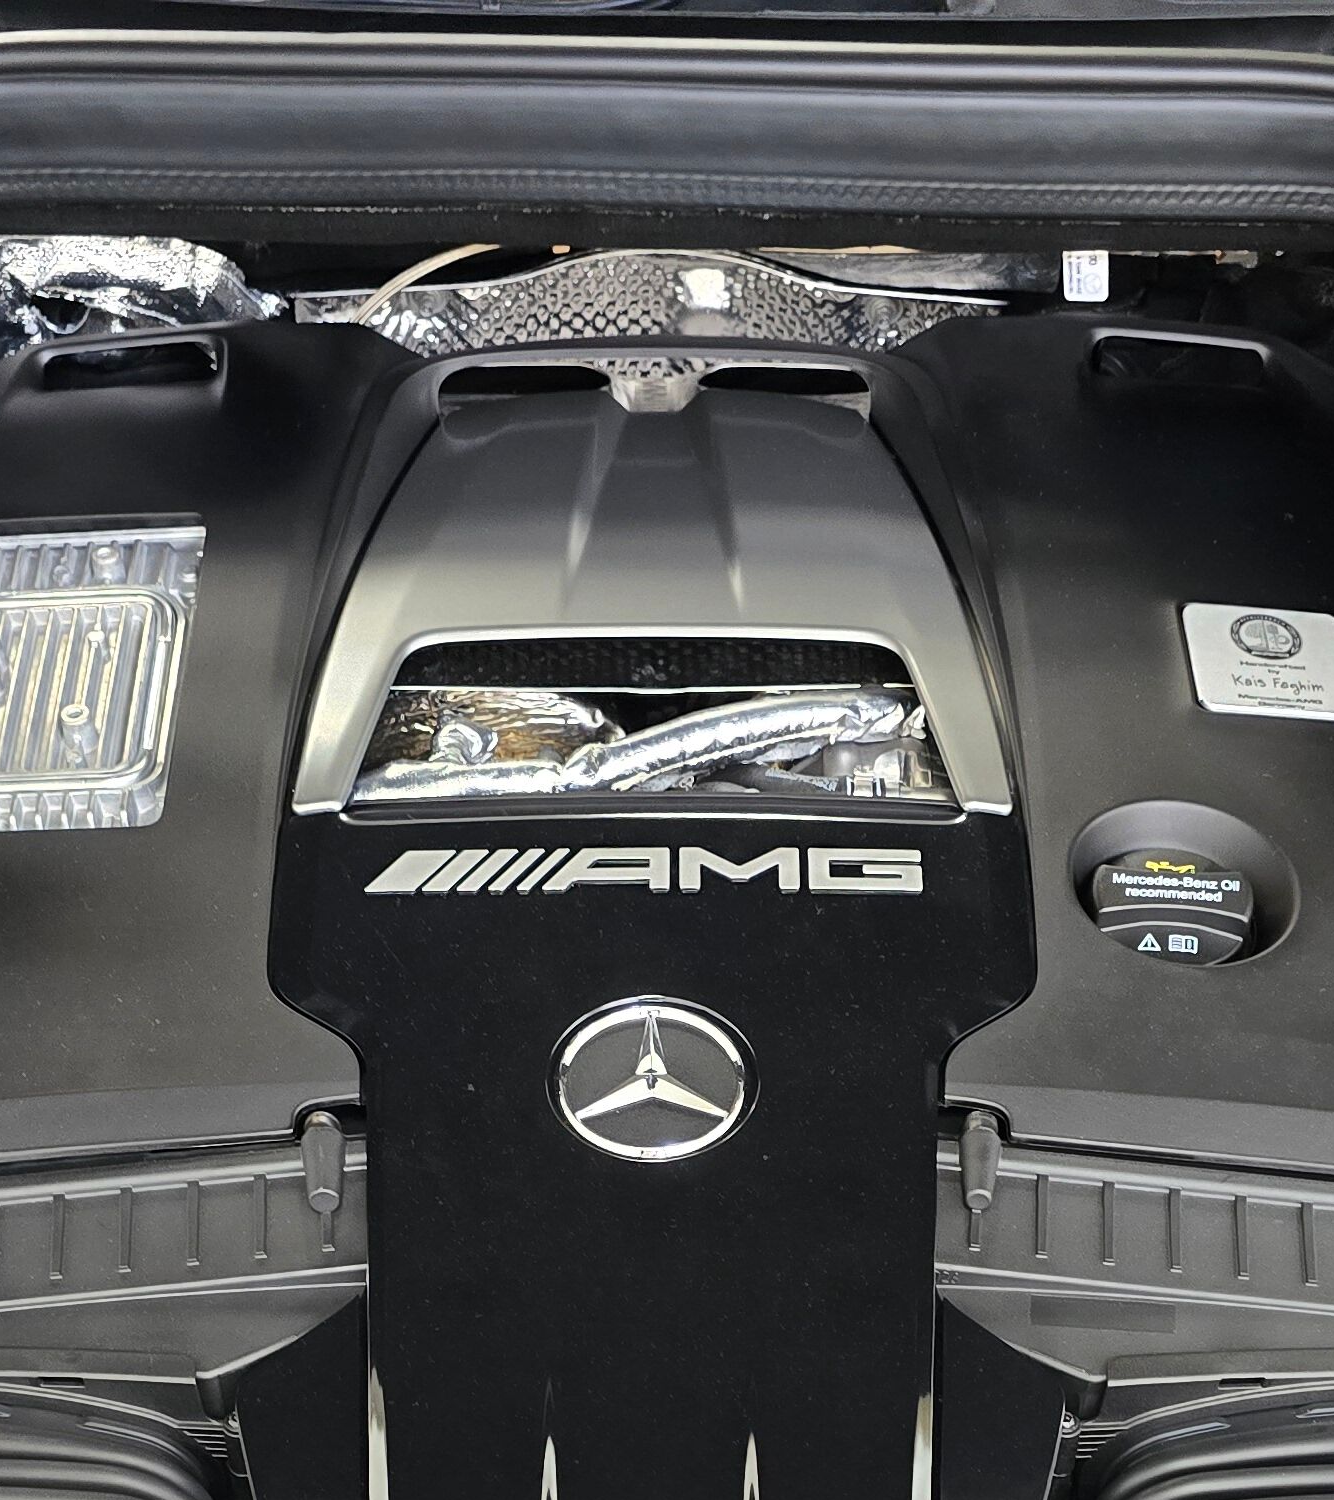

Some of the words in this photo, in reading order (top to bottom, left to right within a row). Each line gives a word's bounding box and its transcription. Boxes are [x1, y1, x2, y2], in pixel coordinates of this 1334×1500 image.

[1231, 673, 1267, 688] Kais
[543, 847, 923, 894] AMG
[1112, 873, 1219, 890] Mercedes-Benz
[1220, 880, 1241, 892] Oil
[1124, 887, 1223, 903] recommended
